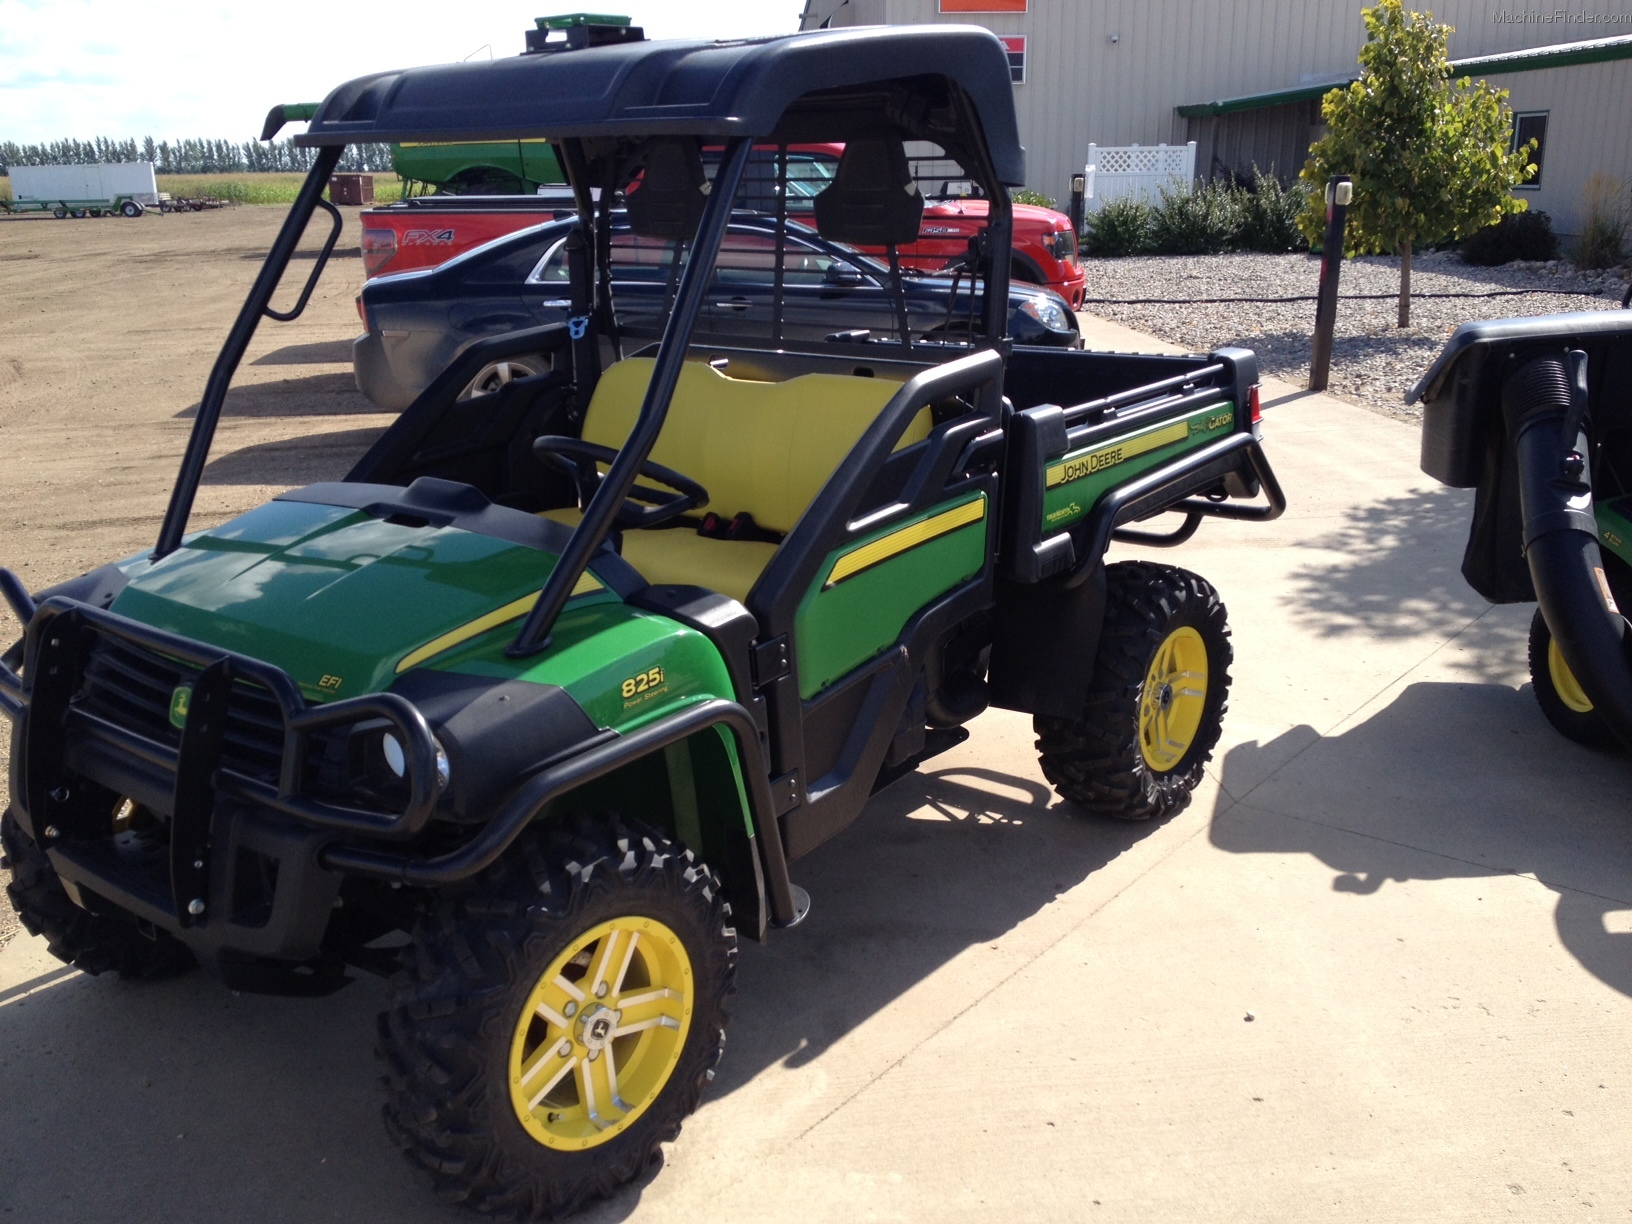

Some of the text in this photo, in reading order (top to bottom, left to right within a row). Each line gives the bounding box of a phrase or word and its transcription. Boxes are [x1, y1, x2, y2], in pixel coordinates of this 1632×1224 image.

[402, 229, 454, 243] FX4
[1208, 412, 1233, 430] GATOR
[1060, 448, 1123, 482] JOHN DEERE
[318, 674, 343, 689] EFI
[621, 666, 665, 698] 825i
[624, 685, 669, 709] Power Steering
